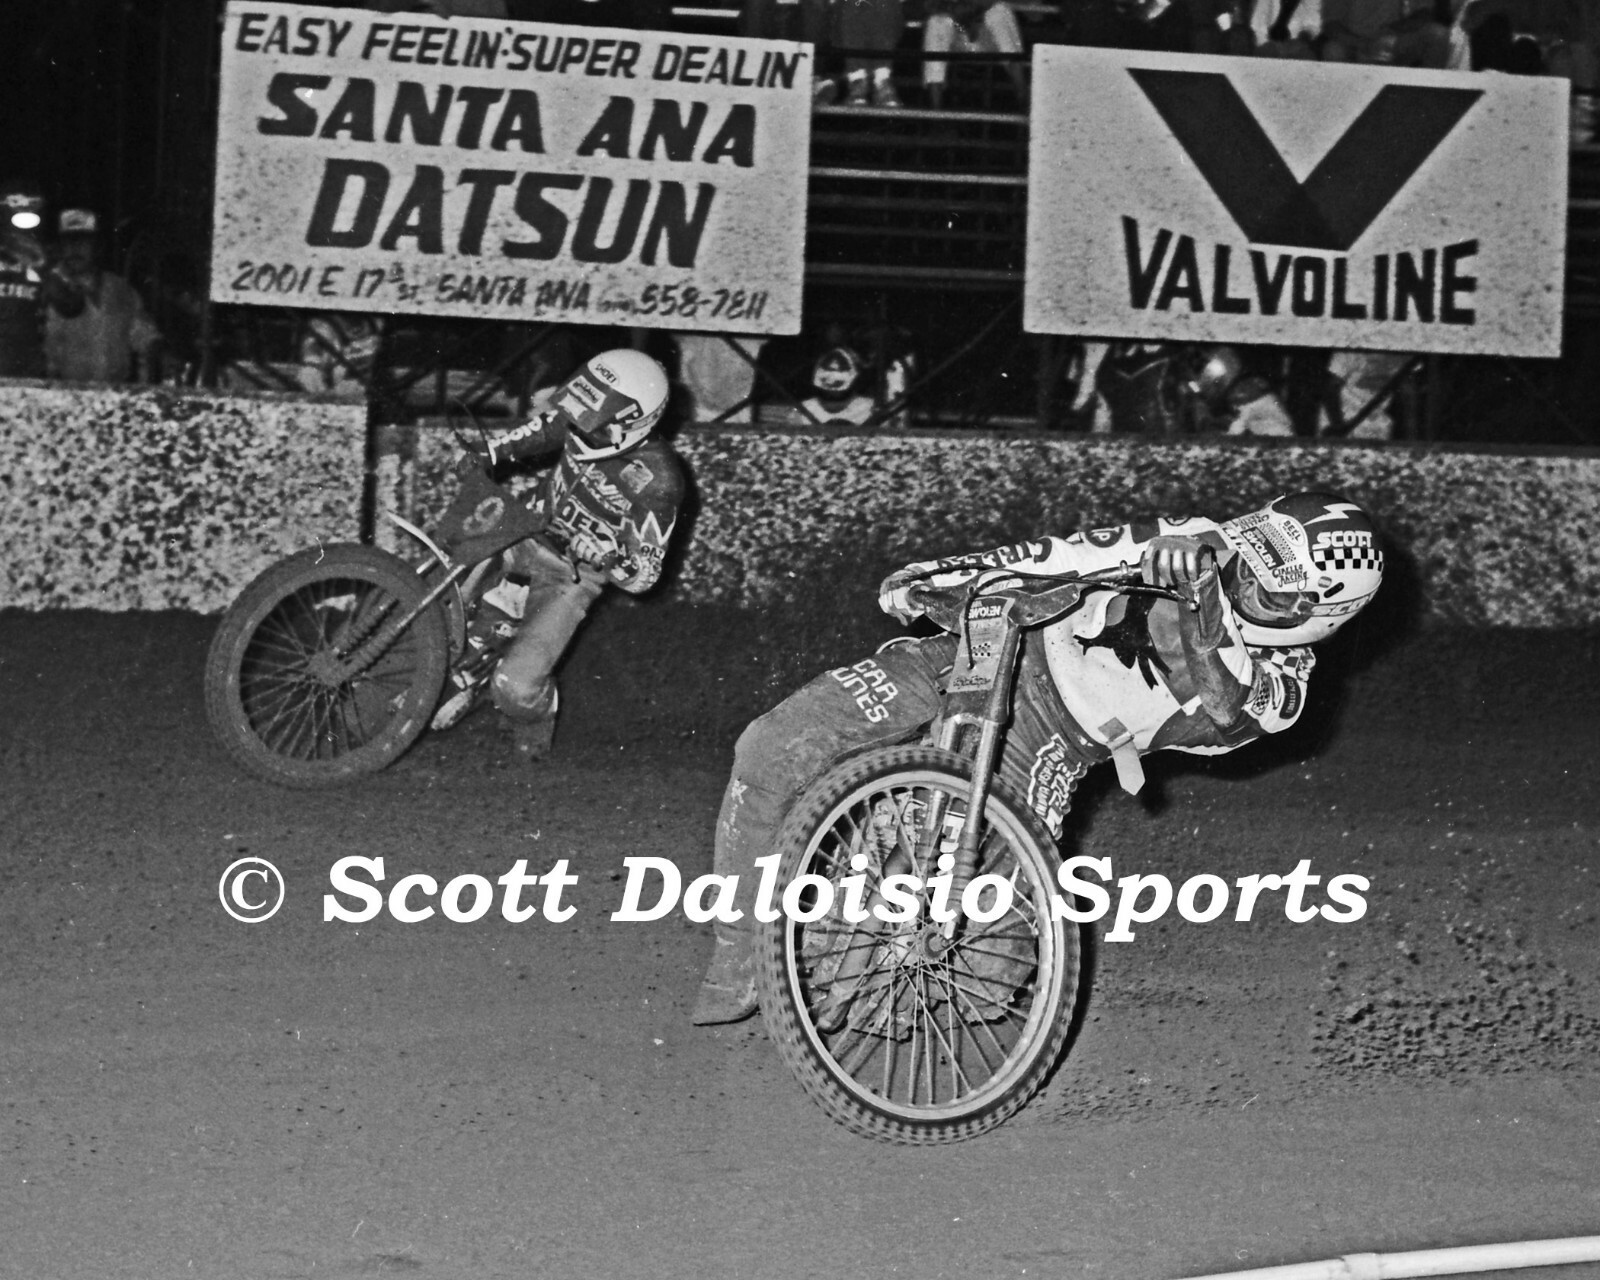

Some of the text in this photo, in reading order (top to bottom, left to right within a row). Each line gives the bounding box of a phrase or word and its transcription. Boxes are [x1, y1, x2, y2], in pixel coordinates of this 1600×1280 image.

[235, 12, 354, 57] EASY
[257, 72, 756, 168] SANTA ANA
[305, 157, 716, 269] DATSUN
[231, 261, 313, 294] 2001
[318, 265, 345, 296] E
[437, 274, 528, 306] SANTA
[536, 279, 591, 311] ANA
[1122, 215, 1479, 325] VALVOLINE
[1312, 530, 1372, 550] SCOTT
[853, 659, 898, 703] CAR
